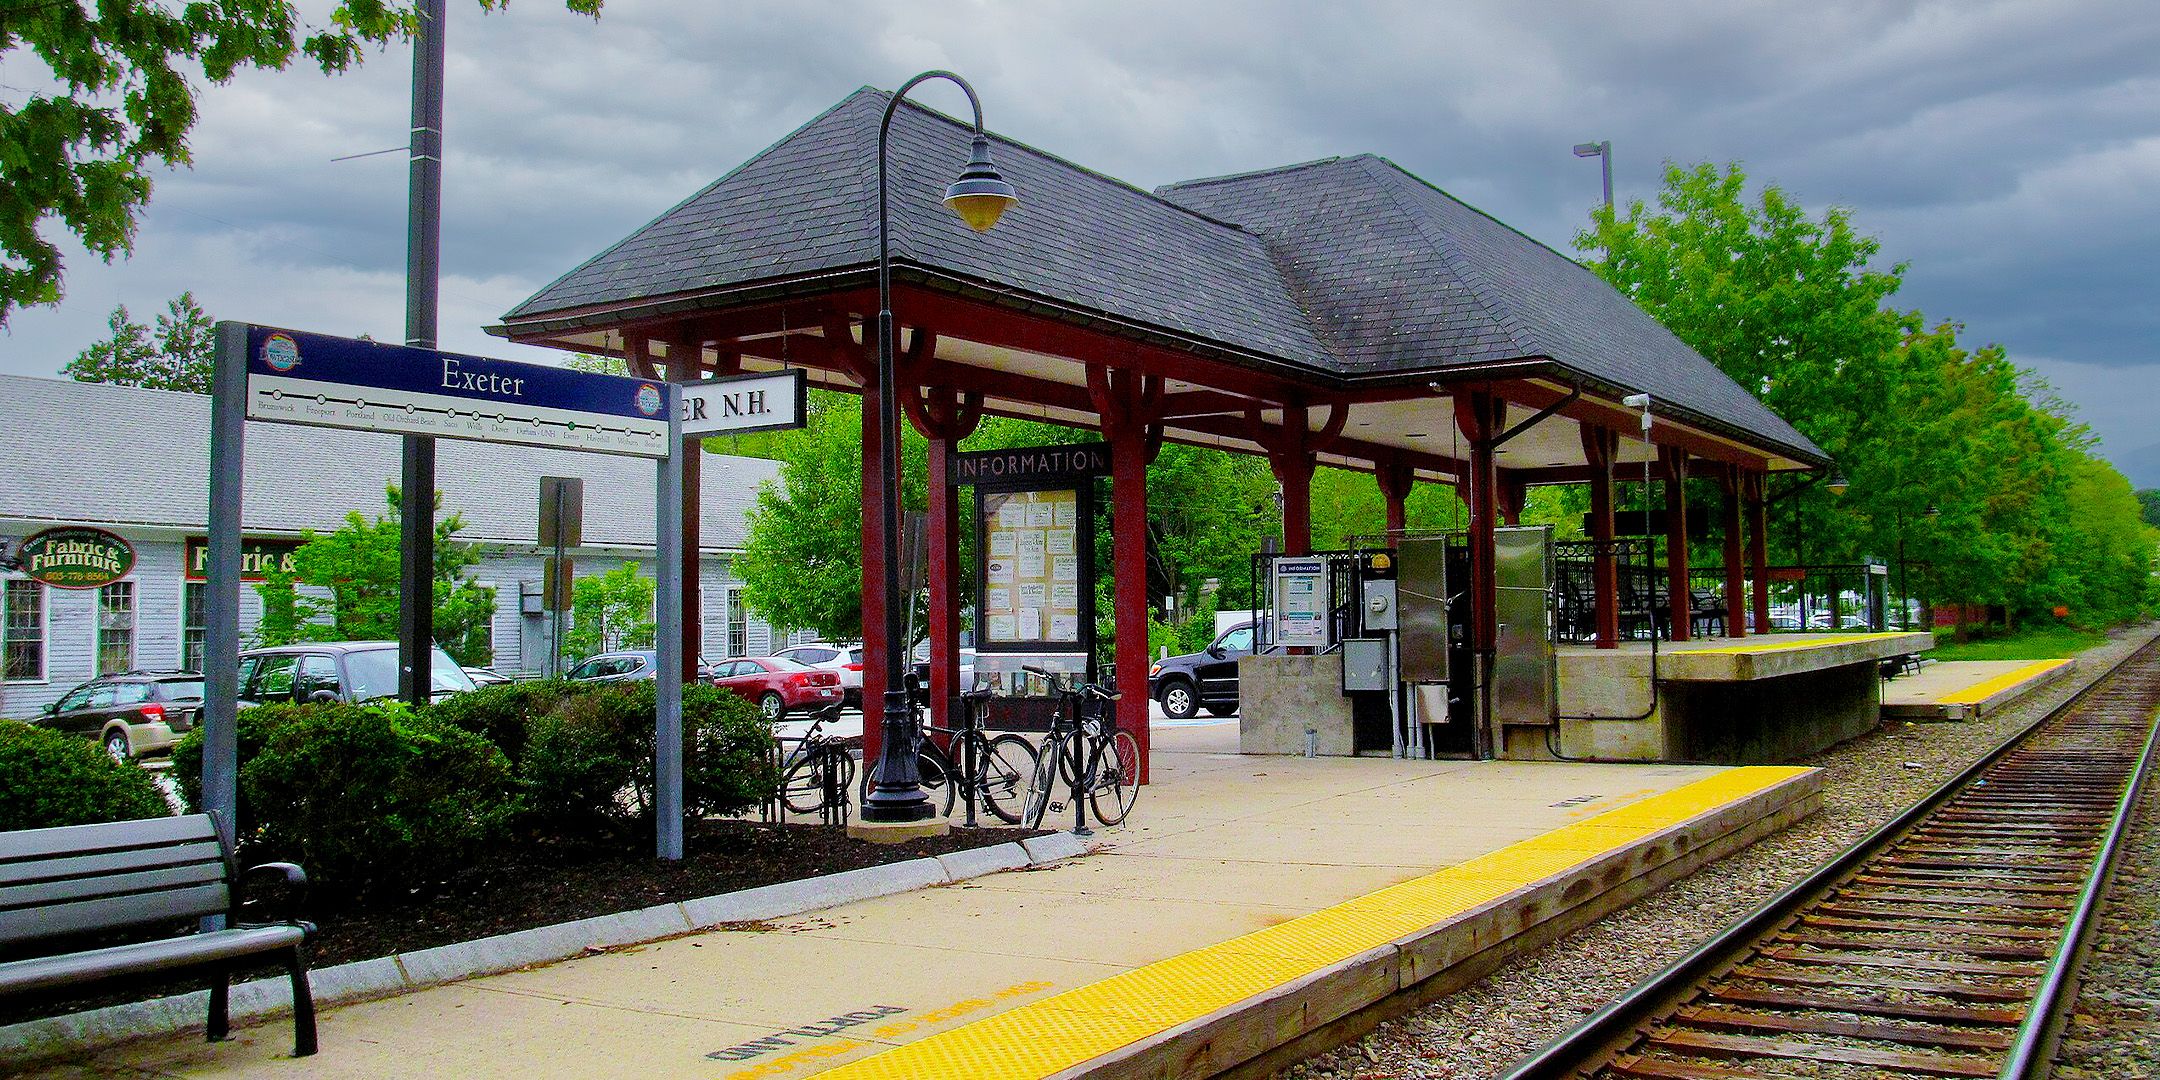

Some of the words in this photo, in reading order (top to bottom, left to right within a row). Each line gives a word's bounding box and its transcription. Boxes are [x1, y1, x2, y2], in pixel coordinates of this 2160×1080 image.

[441, 358, 525, 396] Exeter
[306, 405, 336, 418] Freeport
[346, 409, 375, 421] Portland
[723, 390, 771, 418] N.H.
[383, 413, 395, 422] Old
[957, 451, 1104, 478] INFORMATION
[44, 539, 105, 556] Fabric
[106, 547, 119, 561] &
[194, 545, 275, 572] Fric
[31, 552, 121, 574] Furniture
[705, 1004, 909, 1061] PORTLAND
